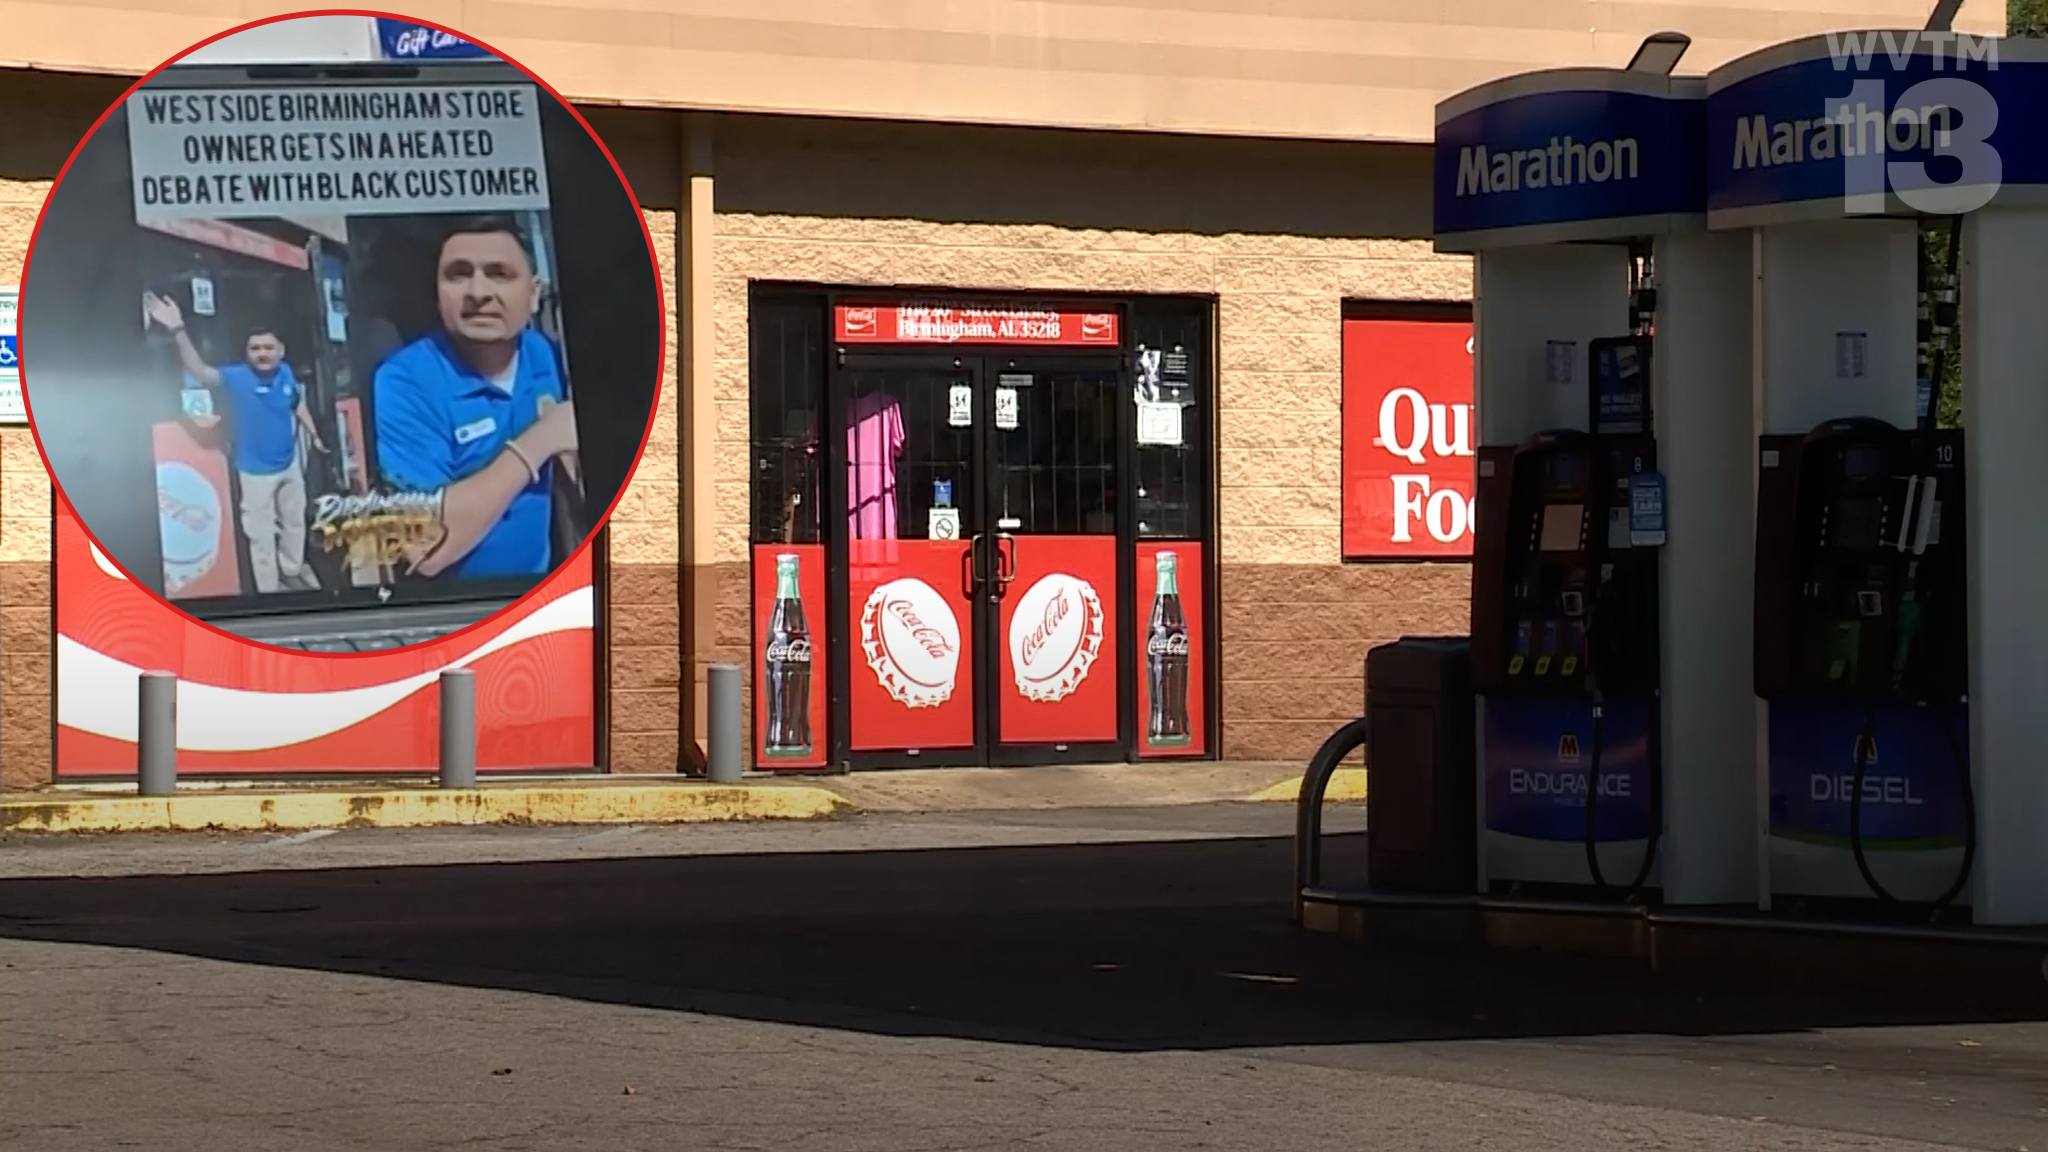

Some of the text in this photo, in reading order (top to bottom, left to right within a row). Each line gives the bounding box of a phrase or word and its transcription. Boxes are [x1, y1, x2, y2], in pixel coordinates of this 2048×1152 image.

[279, 92, 444, 122] BIRMINGHAM
[446, 90, 524, 120] STORE
[184, 129, 494, 164] OWNER GETS IN A HEATED
[1732, 101, 1950, 170] Marathon
[1455, 135, 1638, 197] Marathon
[142, 167, 540, 205] DEBATE WITH BLACK CUSTOMER
[998, 320, 1018, 338] AL
[1020, 321, 1061, 339] 35218
[1633, 456, 1642, 473] 8
[1936, 444, 1953, 462] 10
[887, 600, 955, 659] Coca-Cola
[1022, 584, 1069, 666] Coca-Cola
[1810, 773, 1923, 805] DIESEL
